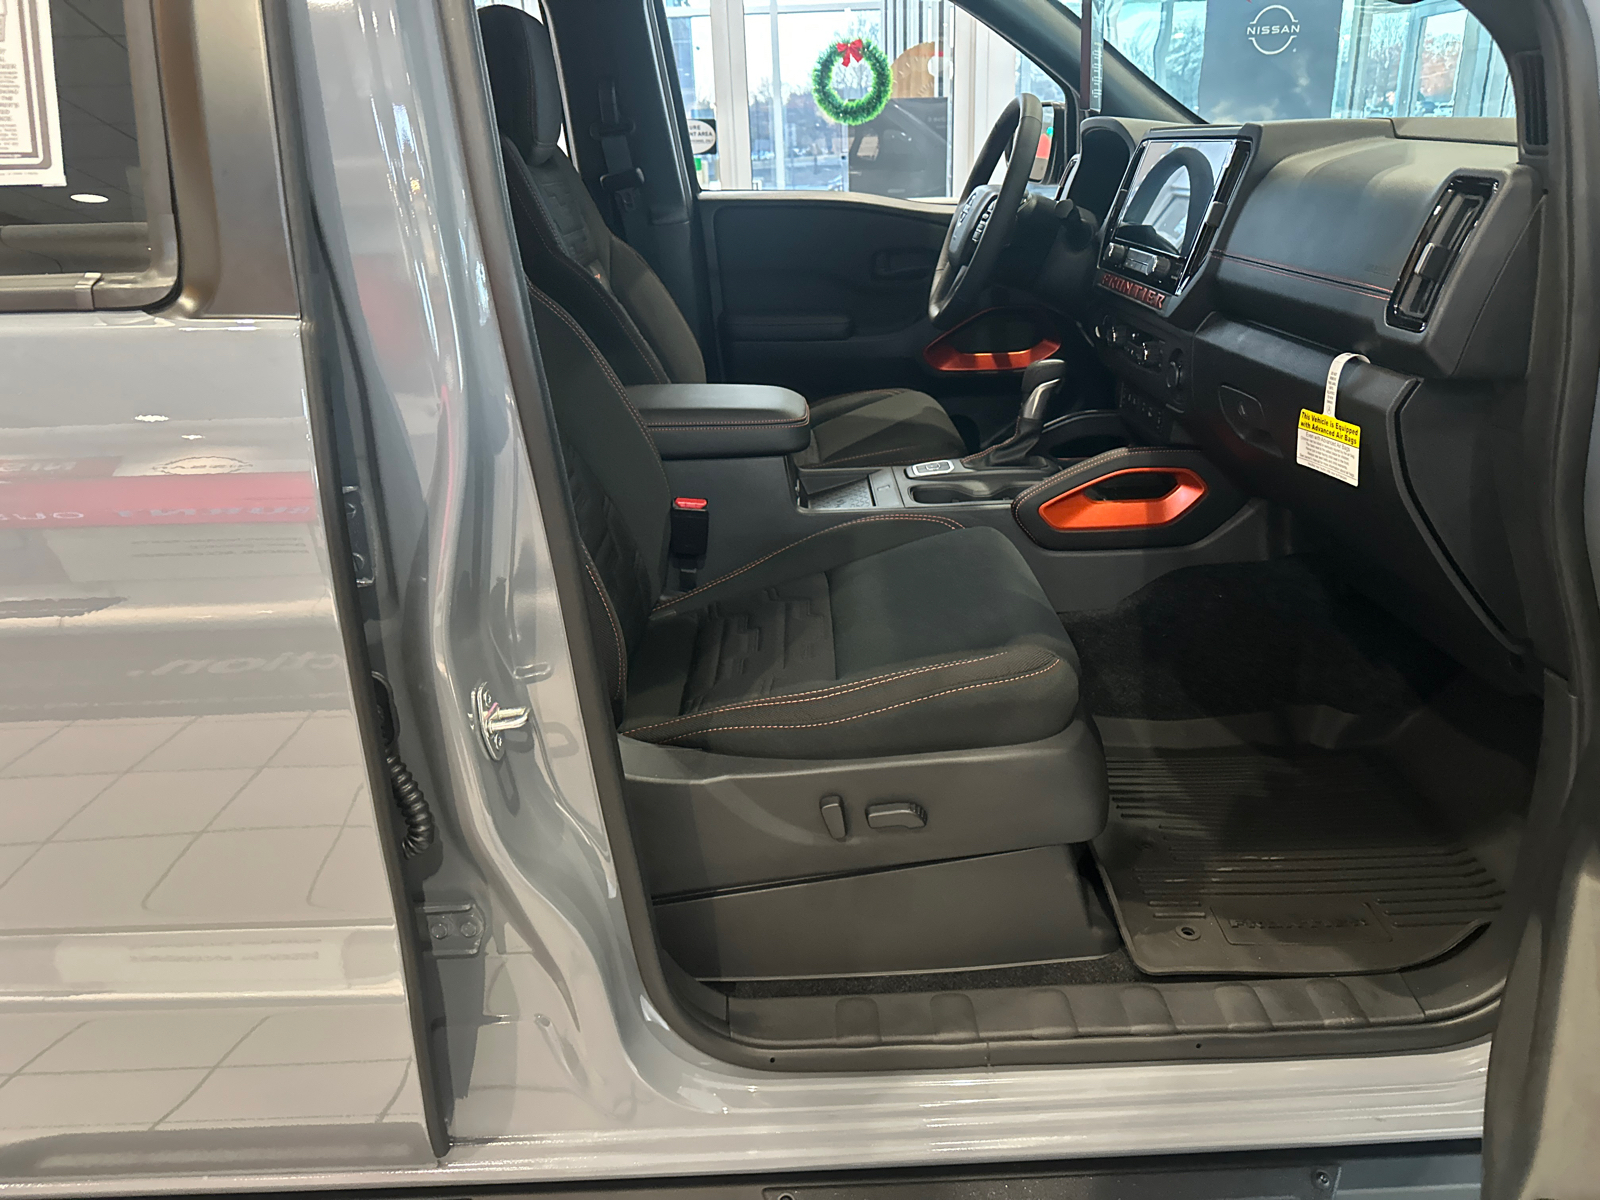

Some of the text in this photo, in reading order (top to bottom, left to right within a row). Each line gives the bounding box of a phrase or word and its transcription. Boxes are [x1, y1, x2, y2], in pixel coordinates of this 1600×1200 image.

[1246, 25, 1300, 35] NISSAN
[1102, 273, 1166, 309] FRONTIER
[1300, 421, 1357, 445] with Advanced Air Bags
[1301, 411, 1311, 421] This
[1311, 414, 1329, 427] Vehicle
[1335, 422, 1359, 436] Equipped
